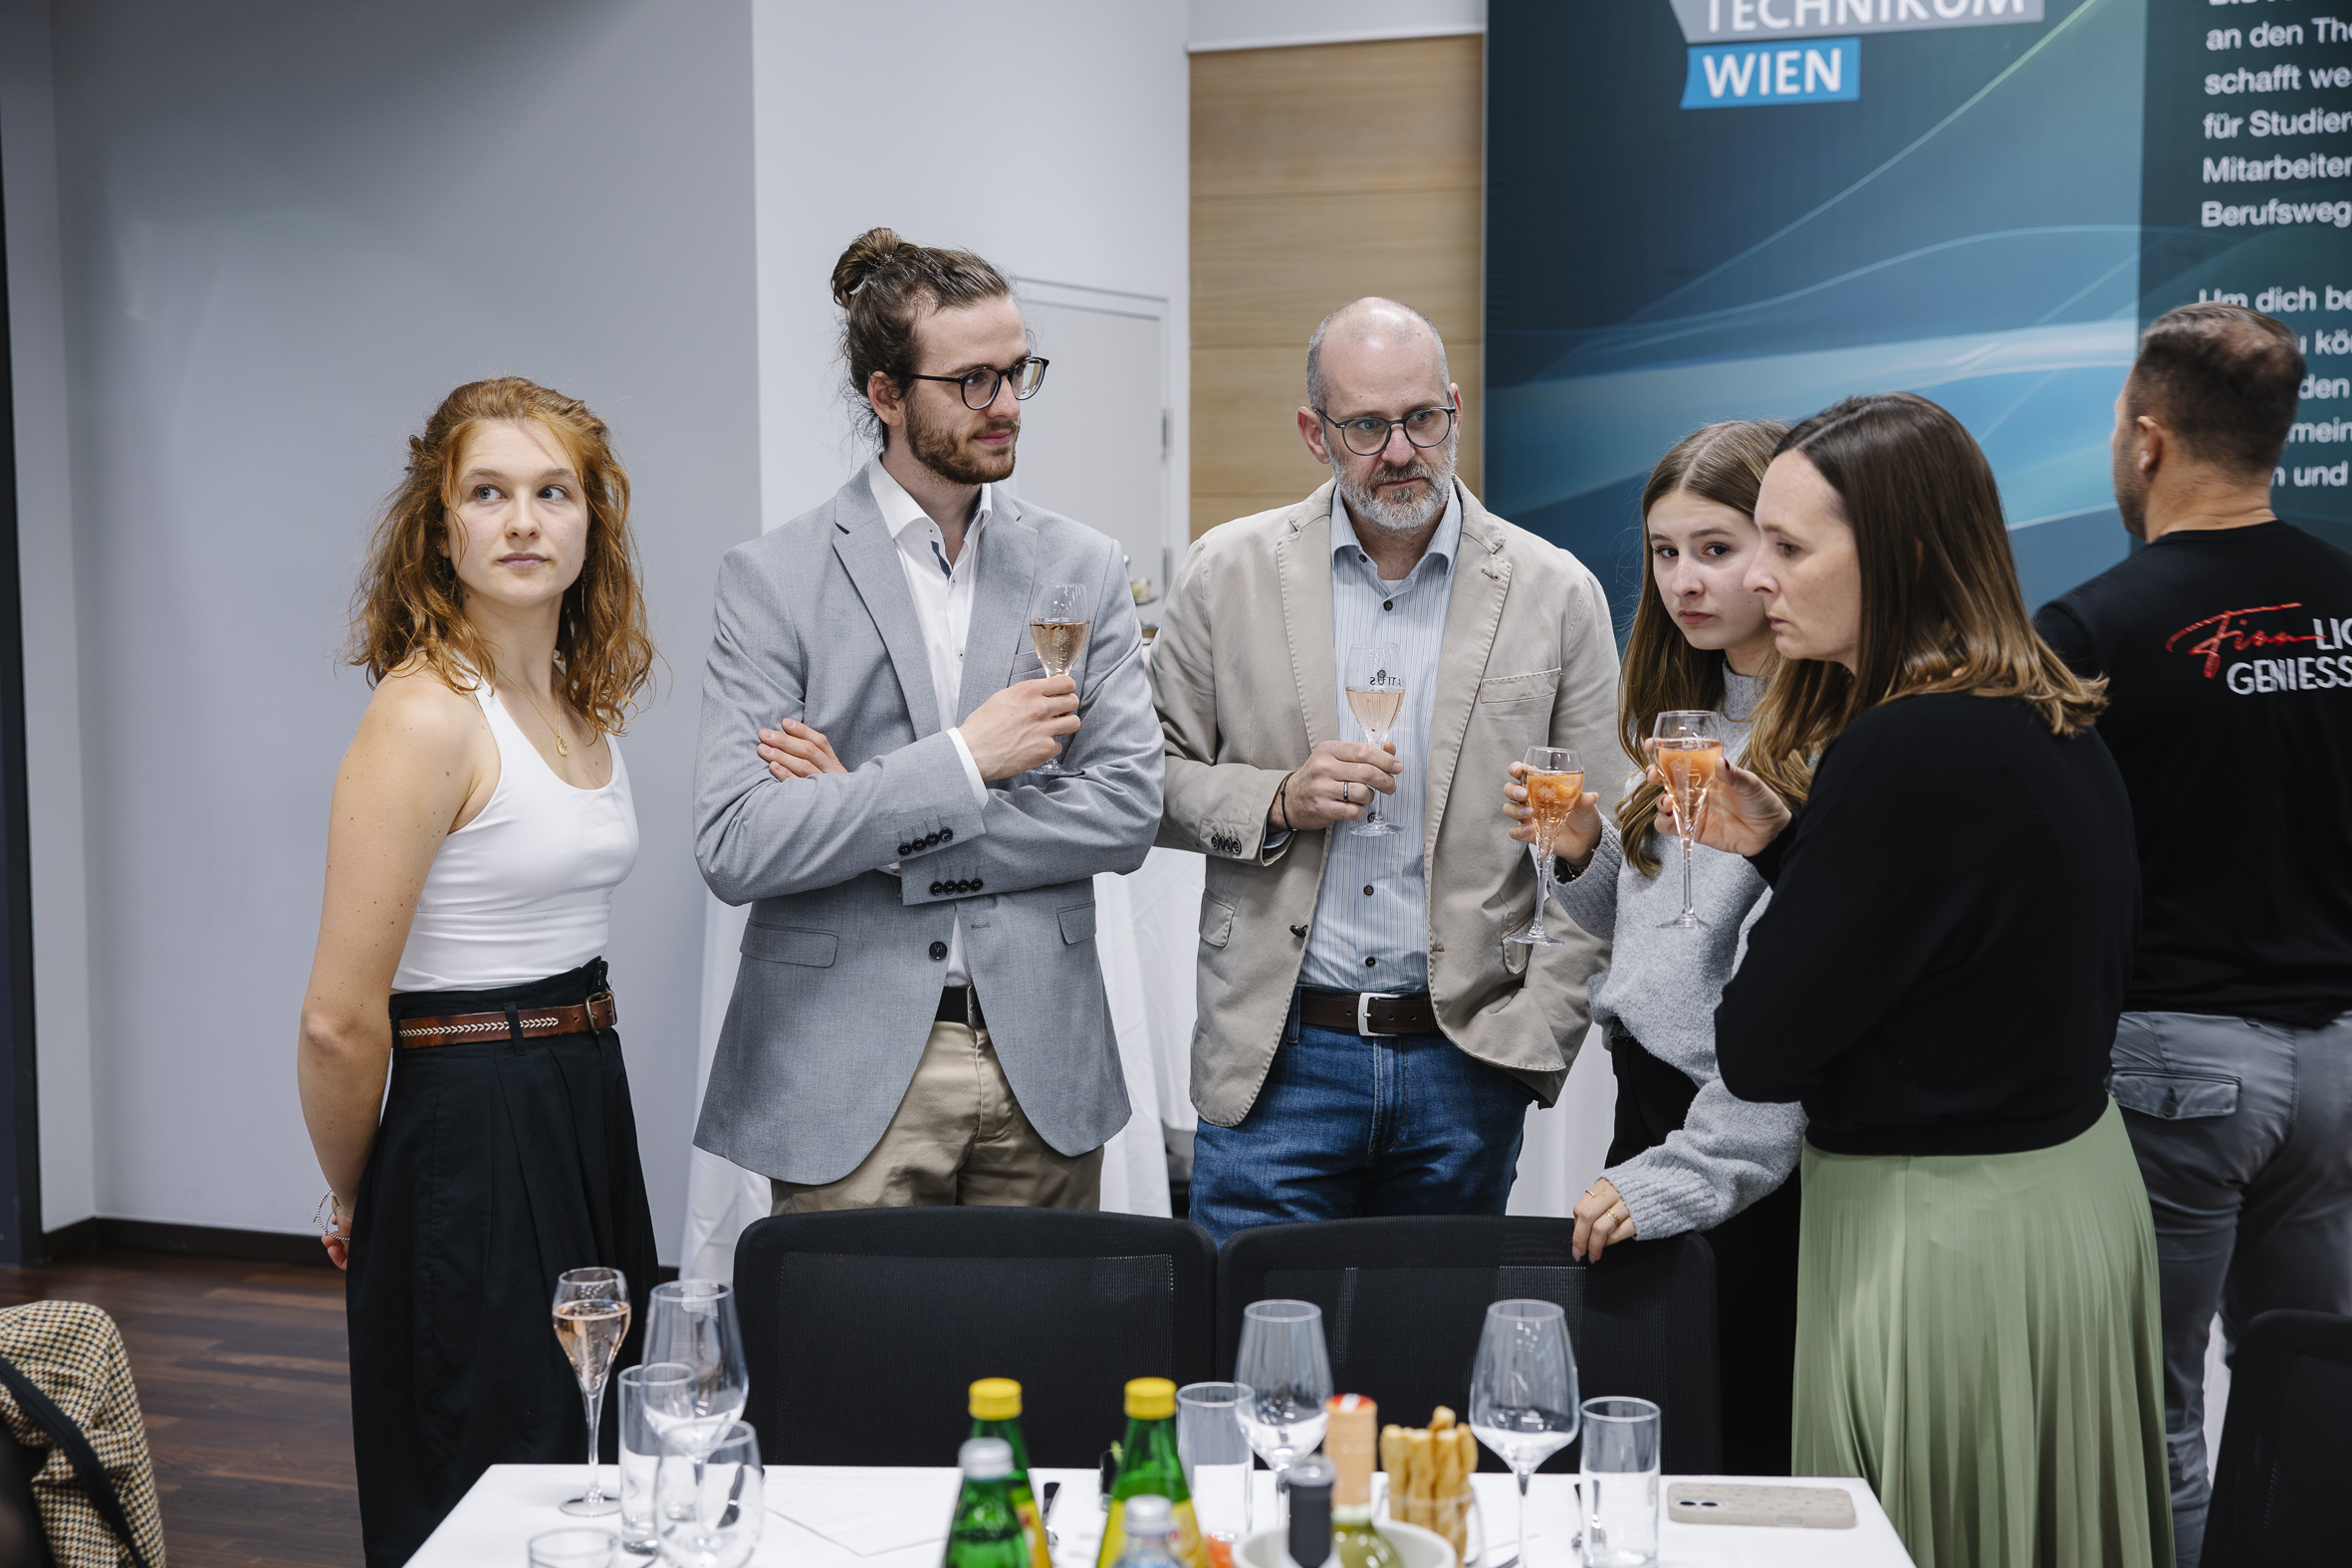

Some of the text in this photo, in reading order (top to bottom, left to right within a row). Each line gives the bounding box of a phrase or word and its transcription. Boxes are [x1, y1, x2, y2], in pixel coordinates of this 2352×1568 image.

[2206, 16, 2352, 51] an den Th
[1702, 48, 1842, 99] WIEN
[2204, 63, 2352, 96] schafft we
[2203, 112, 2243, 139] für
[2201, 198, 2352, 228] Berufsweg
[2254, 285, 2317, 313] dich
[2315, 329, 2352, 354] kö
[2286, 416, 2352, 443] mein
[2293, 460, 2349, 487] und
[2227, 655, 2352, 695] GENIESS
